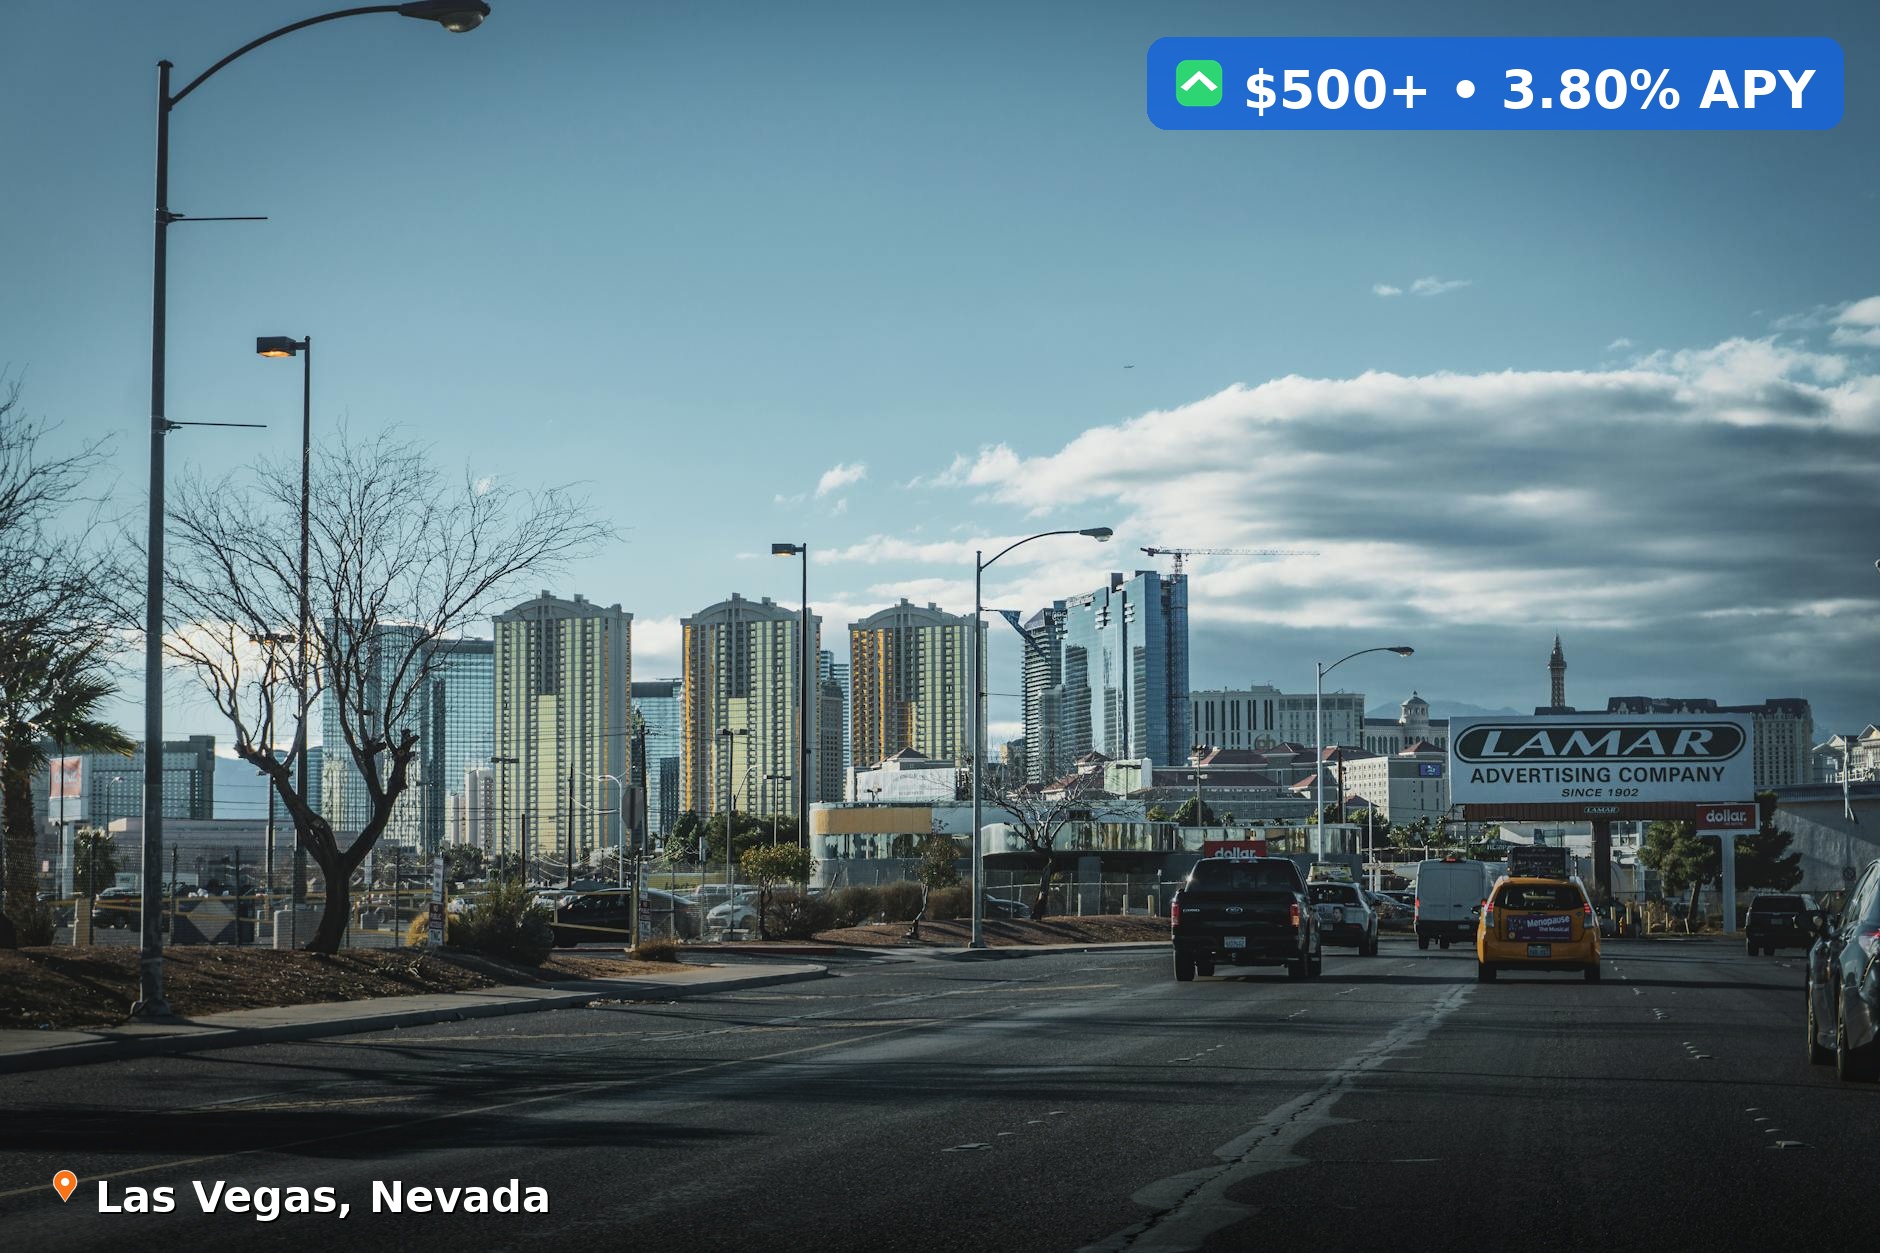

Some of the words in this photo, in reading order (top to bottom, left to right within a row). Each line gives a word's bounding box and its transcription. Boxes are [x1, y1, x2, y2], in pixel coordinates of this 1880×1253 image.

[1480, 729, 1713, 757] LAMAR
[1471, 767, 1611, 784] ADVERTISING
[1618, 766, 1726, 783] COMPANY
[1561, 788, 1603, 798] SINCE
[1608, 787, 1640, 798] 1902
[1526, 915, 1570, 928] Menopause
